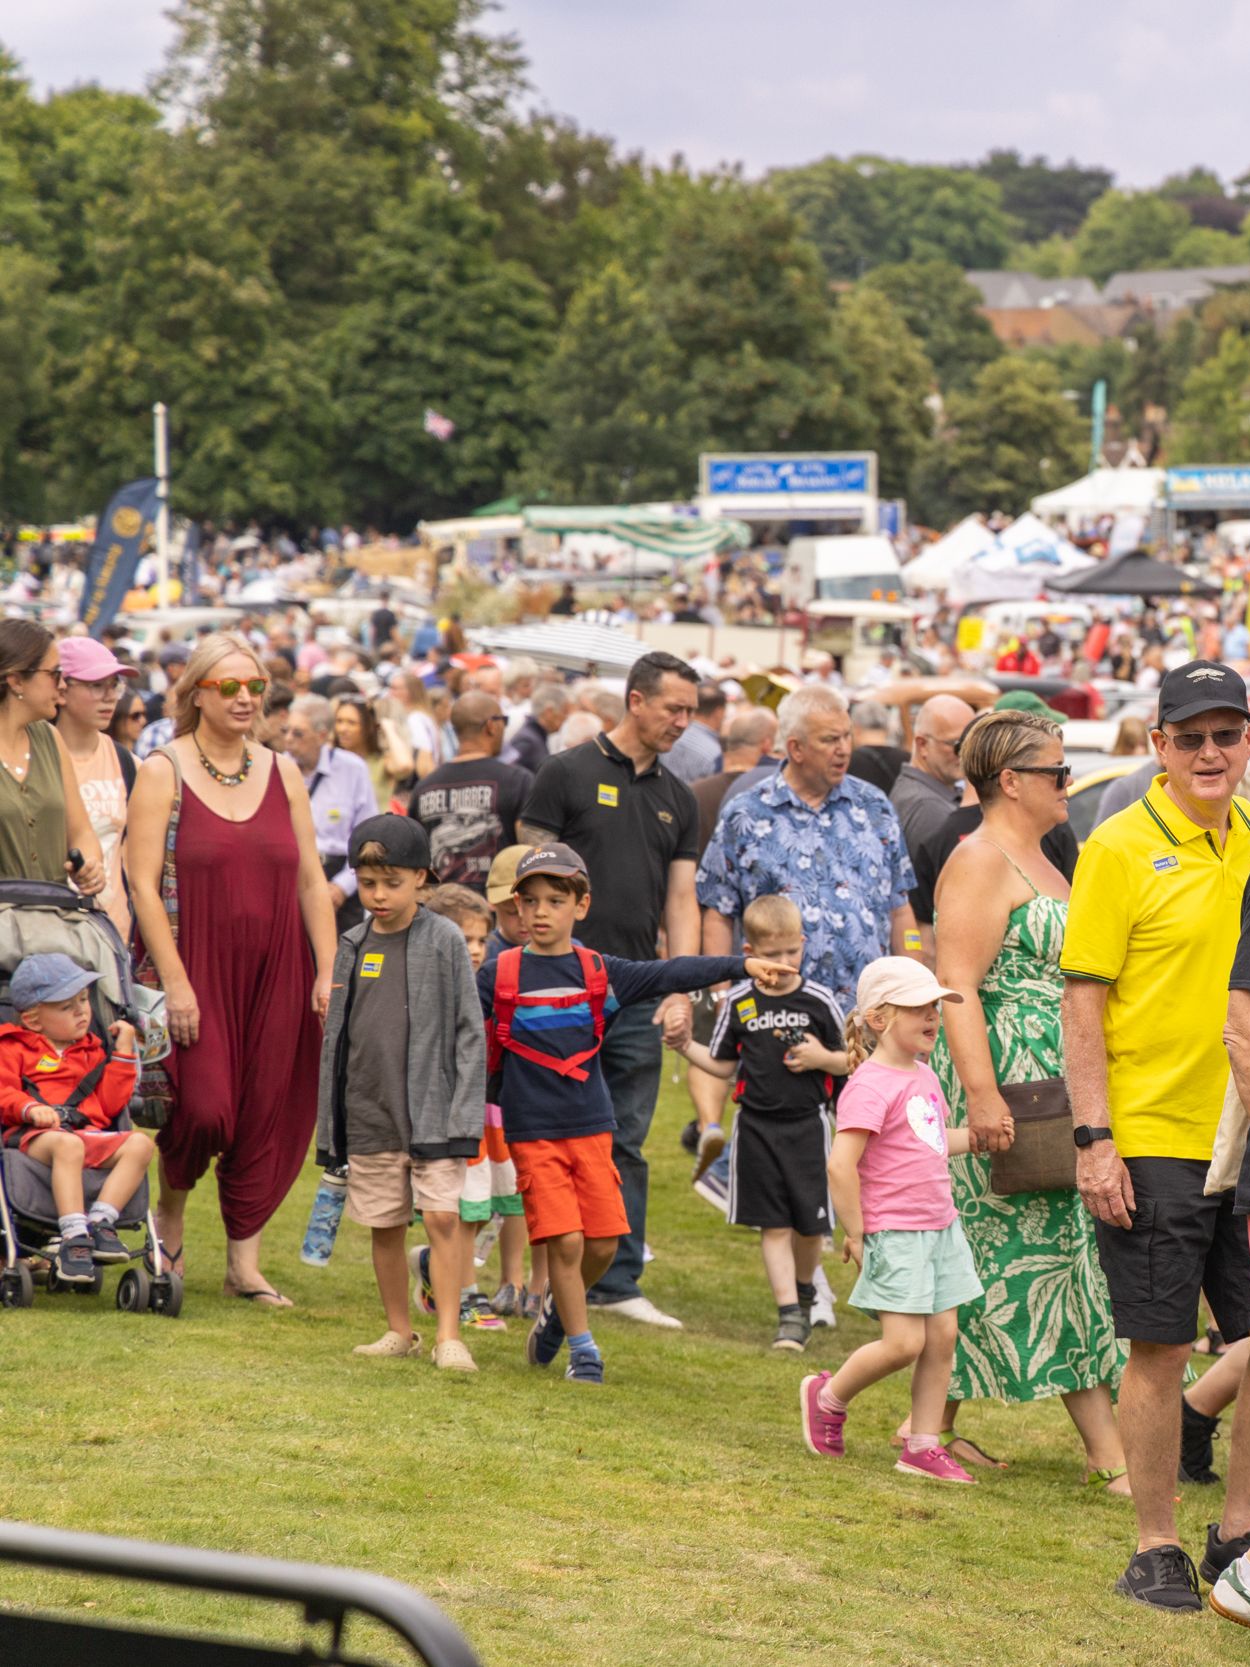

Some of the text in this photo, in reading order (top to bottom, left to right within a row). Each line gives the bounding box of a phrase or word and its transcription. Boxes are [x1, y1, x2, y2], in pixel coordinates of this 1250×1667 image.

[419, 784, 492, 818] REBEL RUBBER
[522, 851, 557, 868] LORD'S
[746, 1009, 810, 1032] adidas
